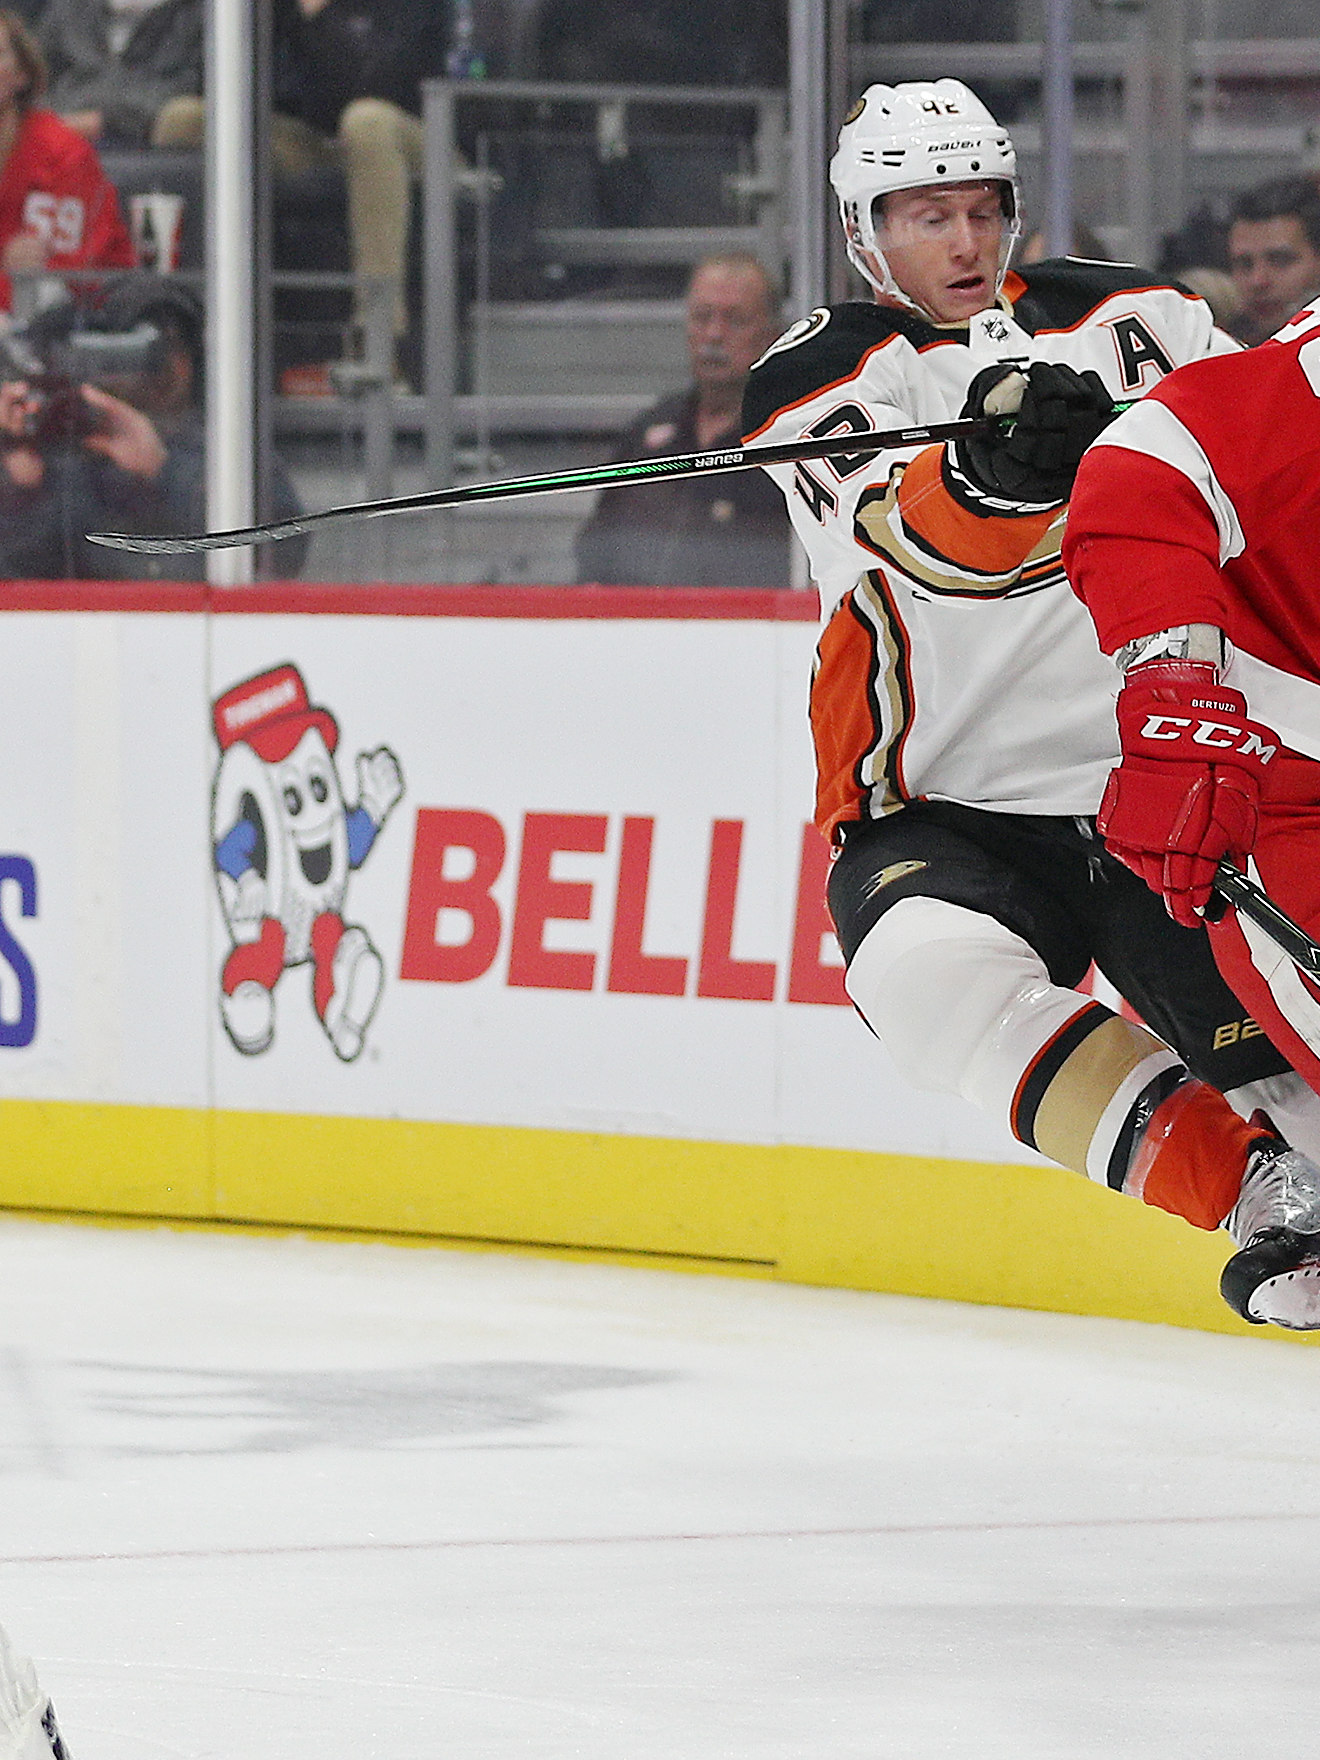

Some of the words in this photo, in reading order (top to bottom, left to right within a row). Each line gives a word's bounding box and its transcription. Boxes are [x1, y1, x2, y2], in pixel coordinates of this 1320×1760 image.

[23, 190, 85, 254] 59
[1096, 311, 1178, 392] A
[694, 452, 744, 468] BAUER
[1191, 698, 1236, 713] BERTUZZI
[1139, 714, 1277, 765] CCM
